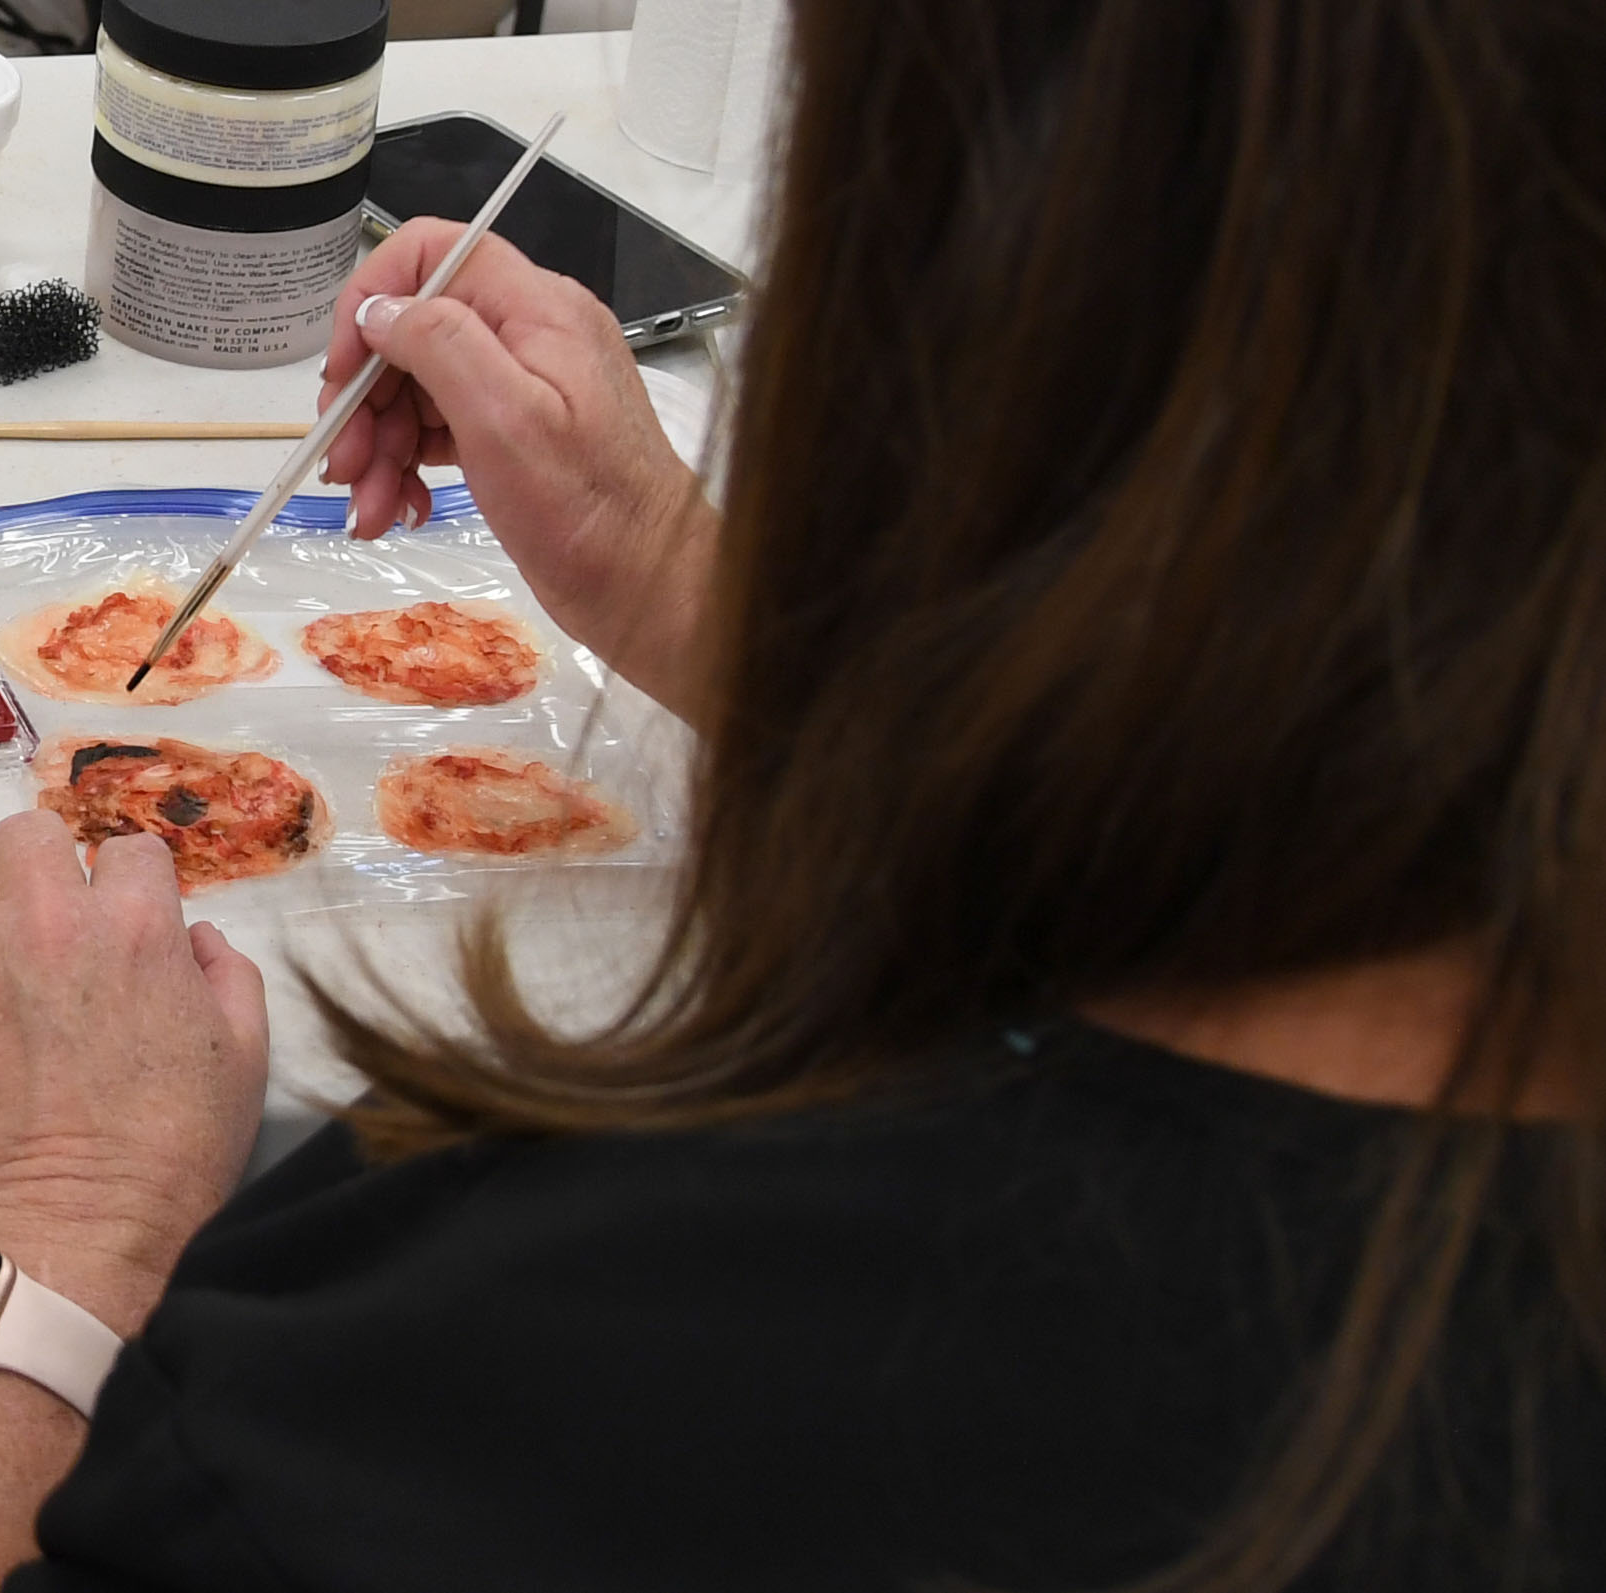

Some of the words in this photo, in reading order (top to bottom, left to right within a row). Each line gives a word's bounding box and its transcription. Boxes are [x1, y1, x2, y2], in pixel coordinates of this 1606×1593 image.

[110, 294, 172, 327] GRAFTOBIAN
[176, 320, 231, 335] MAKE-UP
[235, 324, 291, 337] COMPANY
[213, 344, 244, 354] MADE
[247, 345, 260, 354] IN
